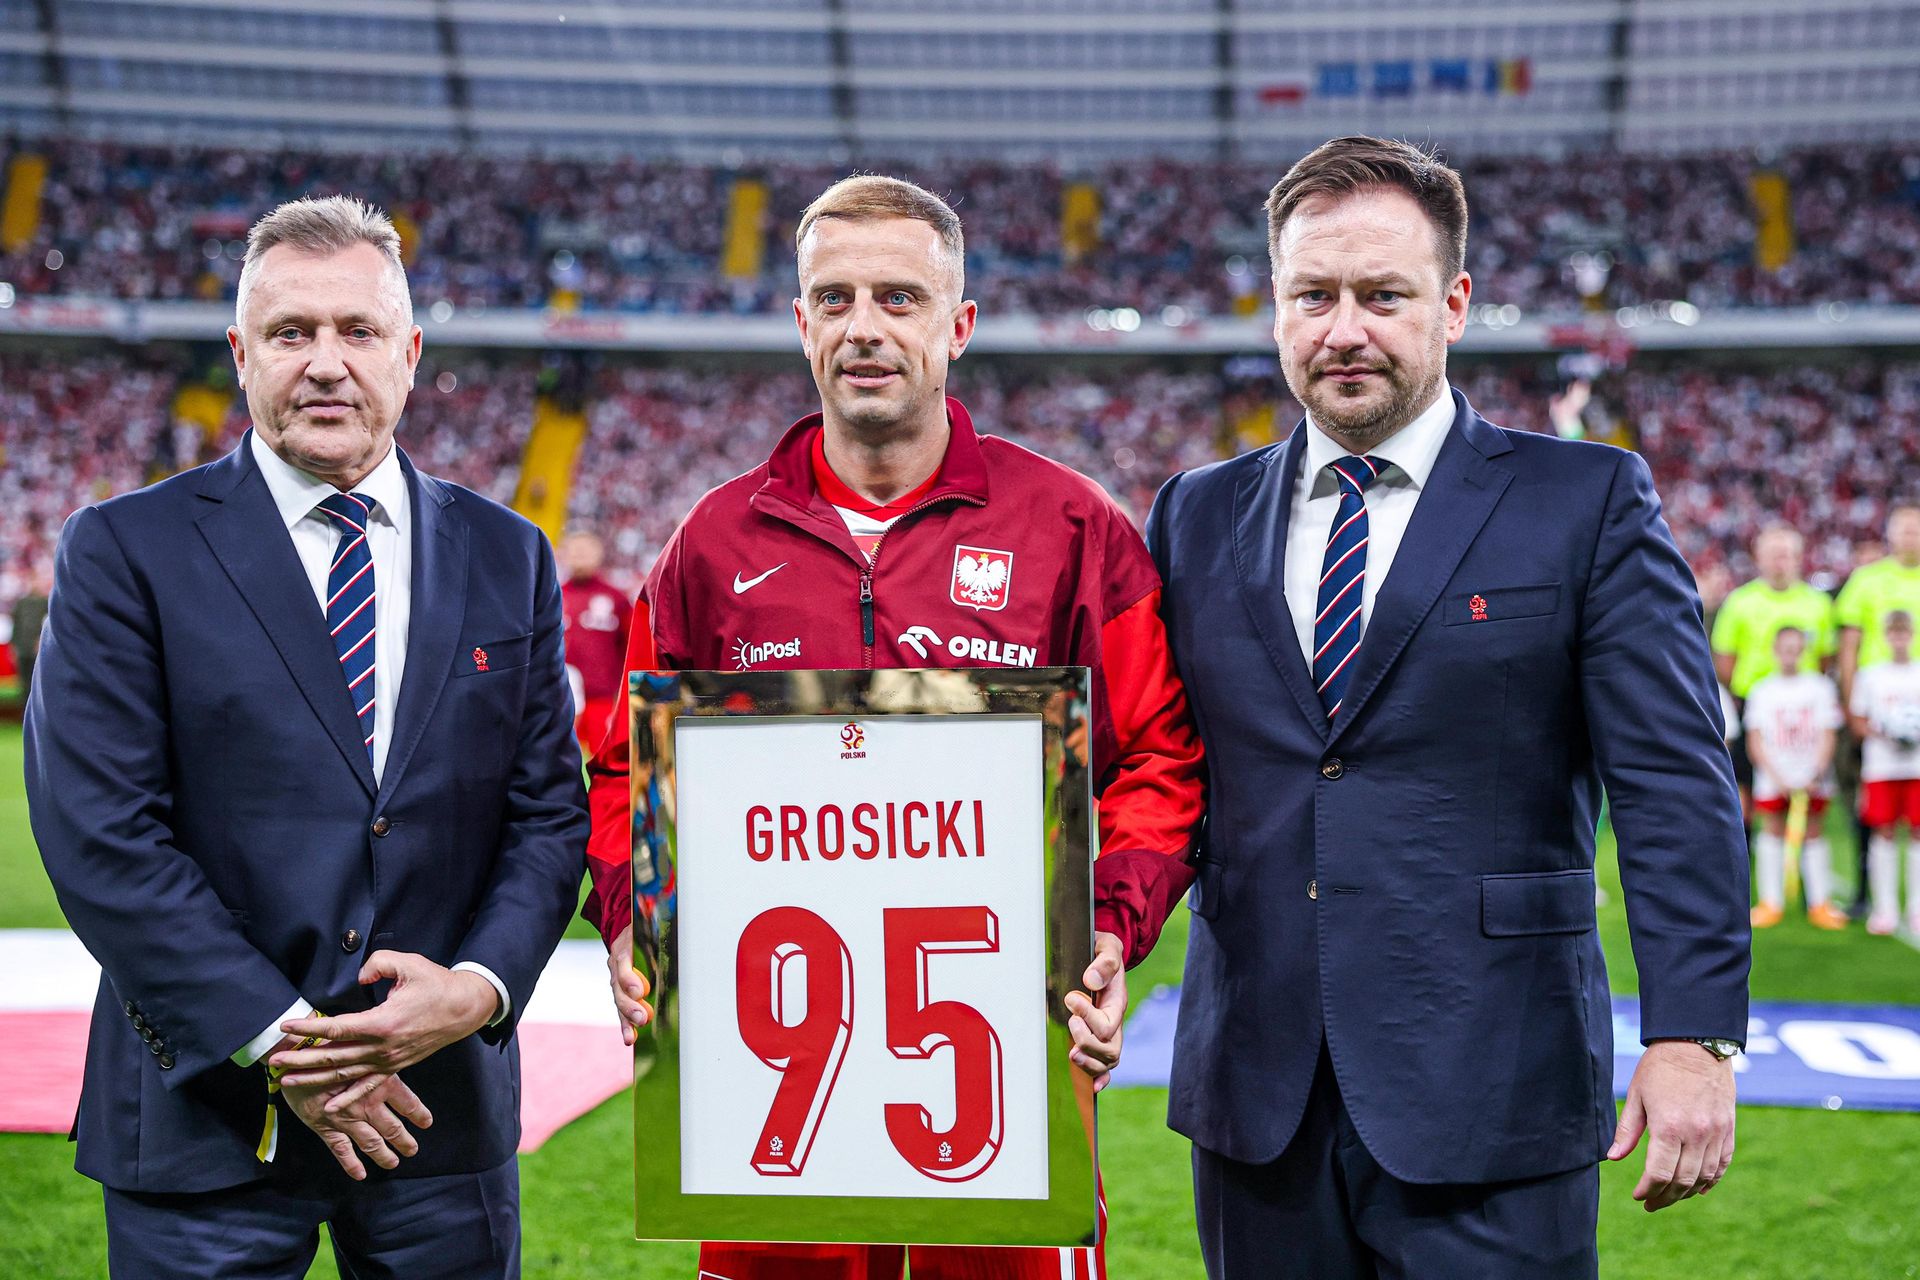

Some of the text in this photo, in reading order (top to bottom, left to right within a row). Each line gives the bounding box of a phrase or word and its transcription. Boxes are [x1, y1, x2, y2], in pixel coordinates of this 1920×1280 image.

[750, 637, 801, 657] InPost
[948, 635, 1038, 668] ORLEN
[840, 750, 866, 760] POLSKA
[746, 800, 985, 862] GROSICKI
[736, 906, 1004, 1183] 95
